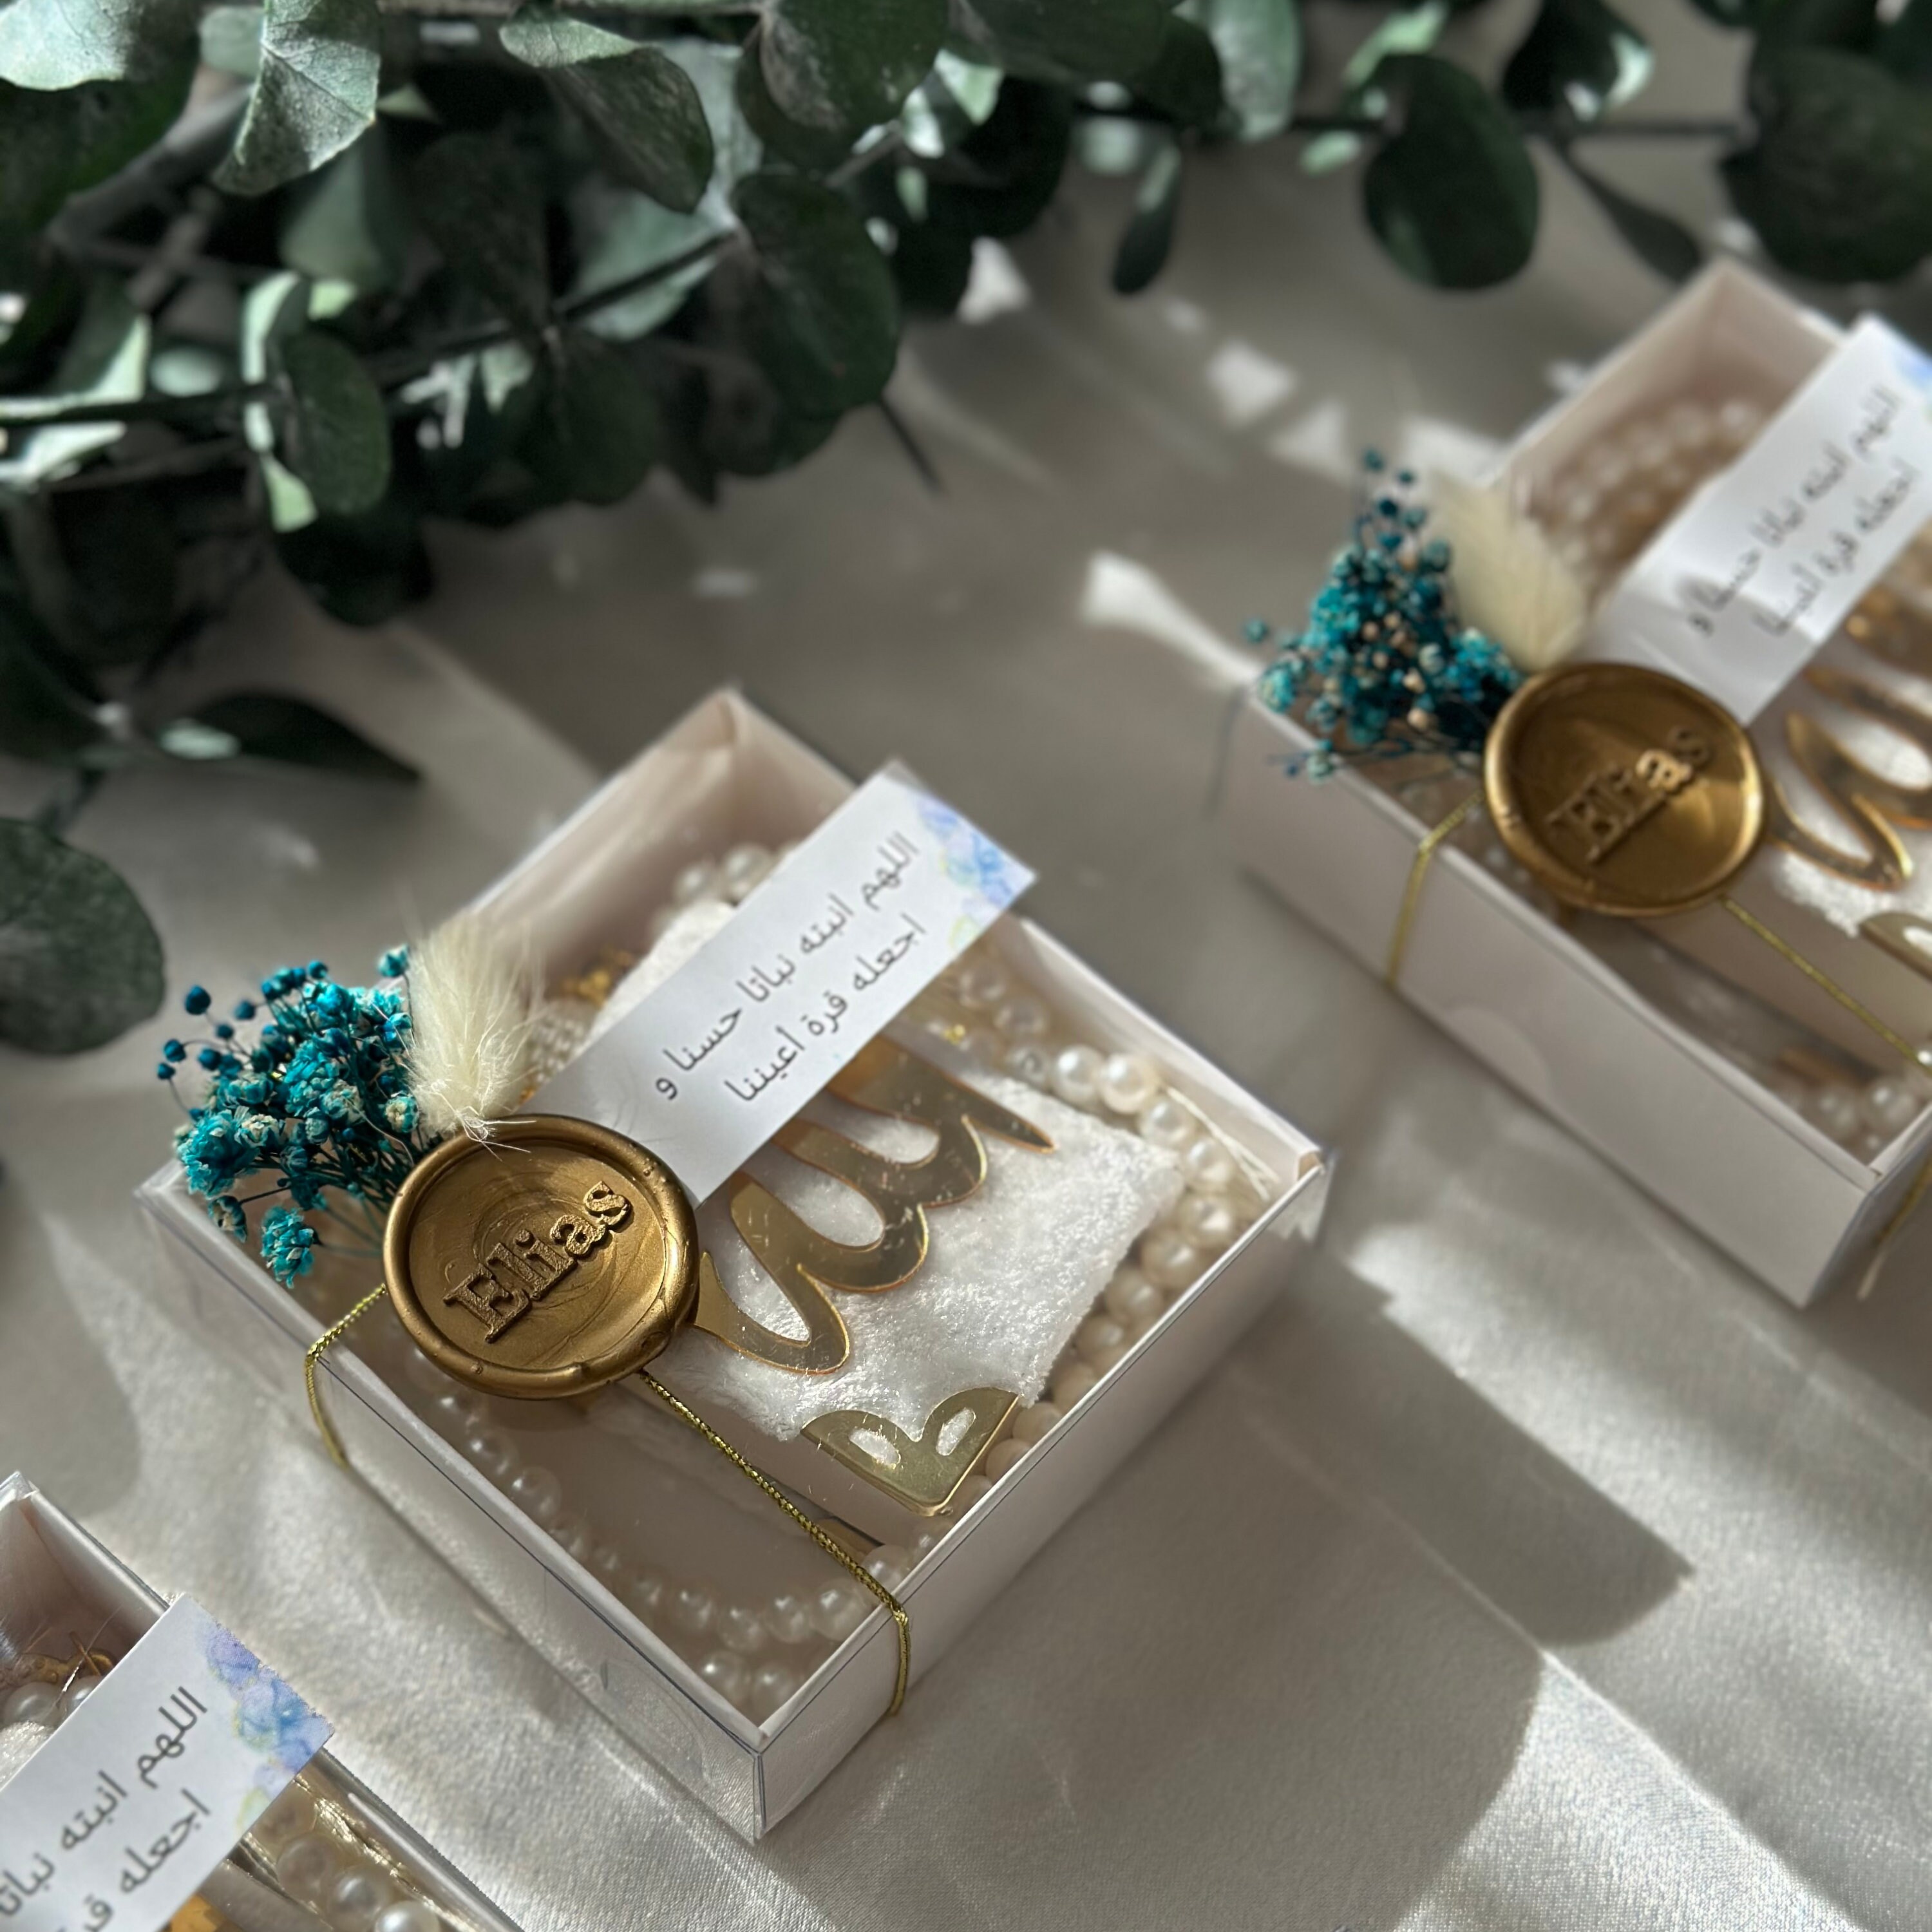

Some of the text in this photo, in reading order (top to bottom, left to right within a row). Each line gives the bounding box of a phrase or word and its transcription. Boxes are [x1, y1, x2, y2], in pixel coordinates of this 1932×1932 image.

[1547, 725, 1710, 863] Elias
[654, 831, 919, 1101] اللهم انبته نباتا حسنا و
[853, 913, 927, 992] اجعله
[800, 990, 849, 1037] قرة
[443, 1180, 631, 1344] Elias
[136, 1685, 208, 1790] اللهم
[60, 1769, 129, 1852] انبته
[119, 1787, 211, 1895] اجعله
[0, 1852, 56, 1918] نبات
